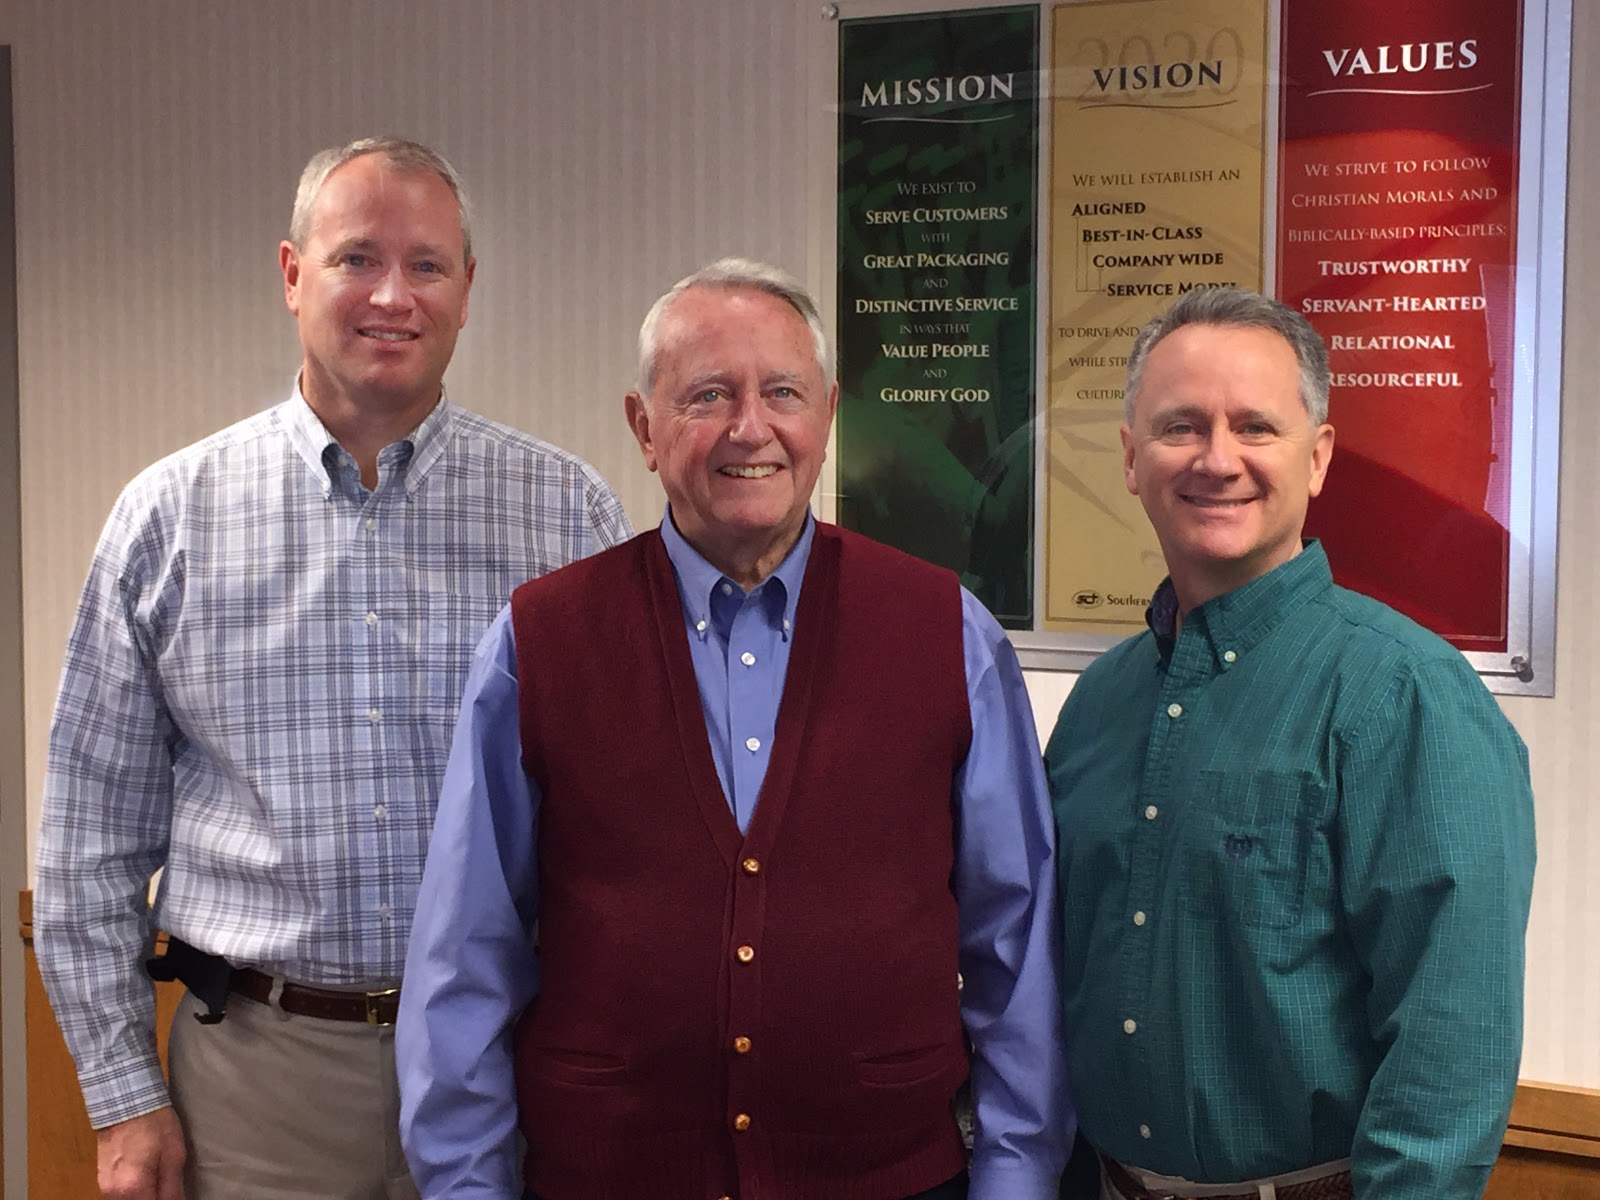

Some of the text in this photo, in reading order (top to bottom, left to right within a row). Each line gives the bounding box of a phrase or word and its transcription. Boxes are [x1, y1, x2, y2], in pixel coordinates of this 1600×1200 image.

[1076, 27, 1244, 102] 2020
[1322, 39, 1478, 77] VALUES
[1093, 60, 1223, 92] VISION
[860, 73, 1015, 108] MISSION
[1304, 157, 1492, 176] WE STRIVE TO FOLLOW
[1073, 169, 1241, 187] WE WILL ESTABLISH AN
[897, 181, 976, 196] WE EXIST TO
[1291, 187, 1498, 208] CHRISTIAN MORALS AND
[865, 206, 1009, 225] SERVE CUSTOMERS
[1071, 202, 1146, 217] ALIGNED
[921, 232, 950, 243] WITH
[1082, 226, 1203, 243] BEST-IN-CLASS
[1288, 226, 1415, 243] BIBLICALLY-BASED
[863, 252, 1009, 269] GREAT PACKAGING
[1092, 253, 1224, 268] COMPANY WIDE
[1317, 258, 1472, 276] TRUSTWORTHY
[922, 278, 949, 289] AND
[1107, 283, 1174, 297] SERVICE
[855, 297, 1019, 314] DISTINCTIVE SERVICE
[1302, 296, 1487, 313] SERVANT-HEARTED
[900, 323, 970, 335] IN WAYS THAT
[1058, 326, 1140, 338] TO DRIVE AND
[881, 343, 990, 358] VALUE PEOPLE
[1330, 335, 1456, 351] RELATIONAL
[1069, 357, 1106, 367] WHILE
[922, 368, 947, 379] AND
[880, 387, 990, 403] GLORIFY GOD
